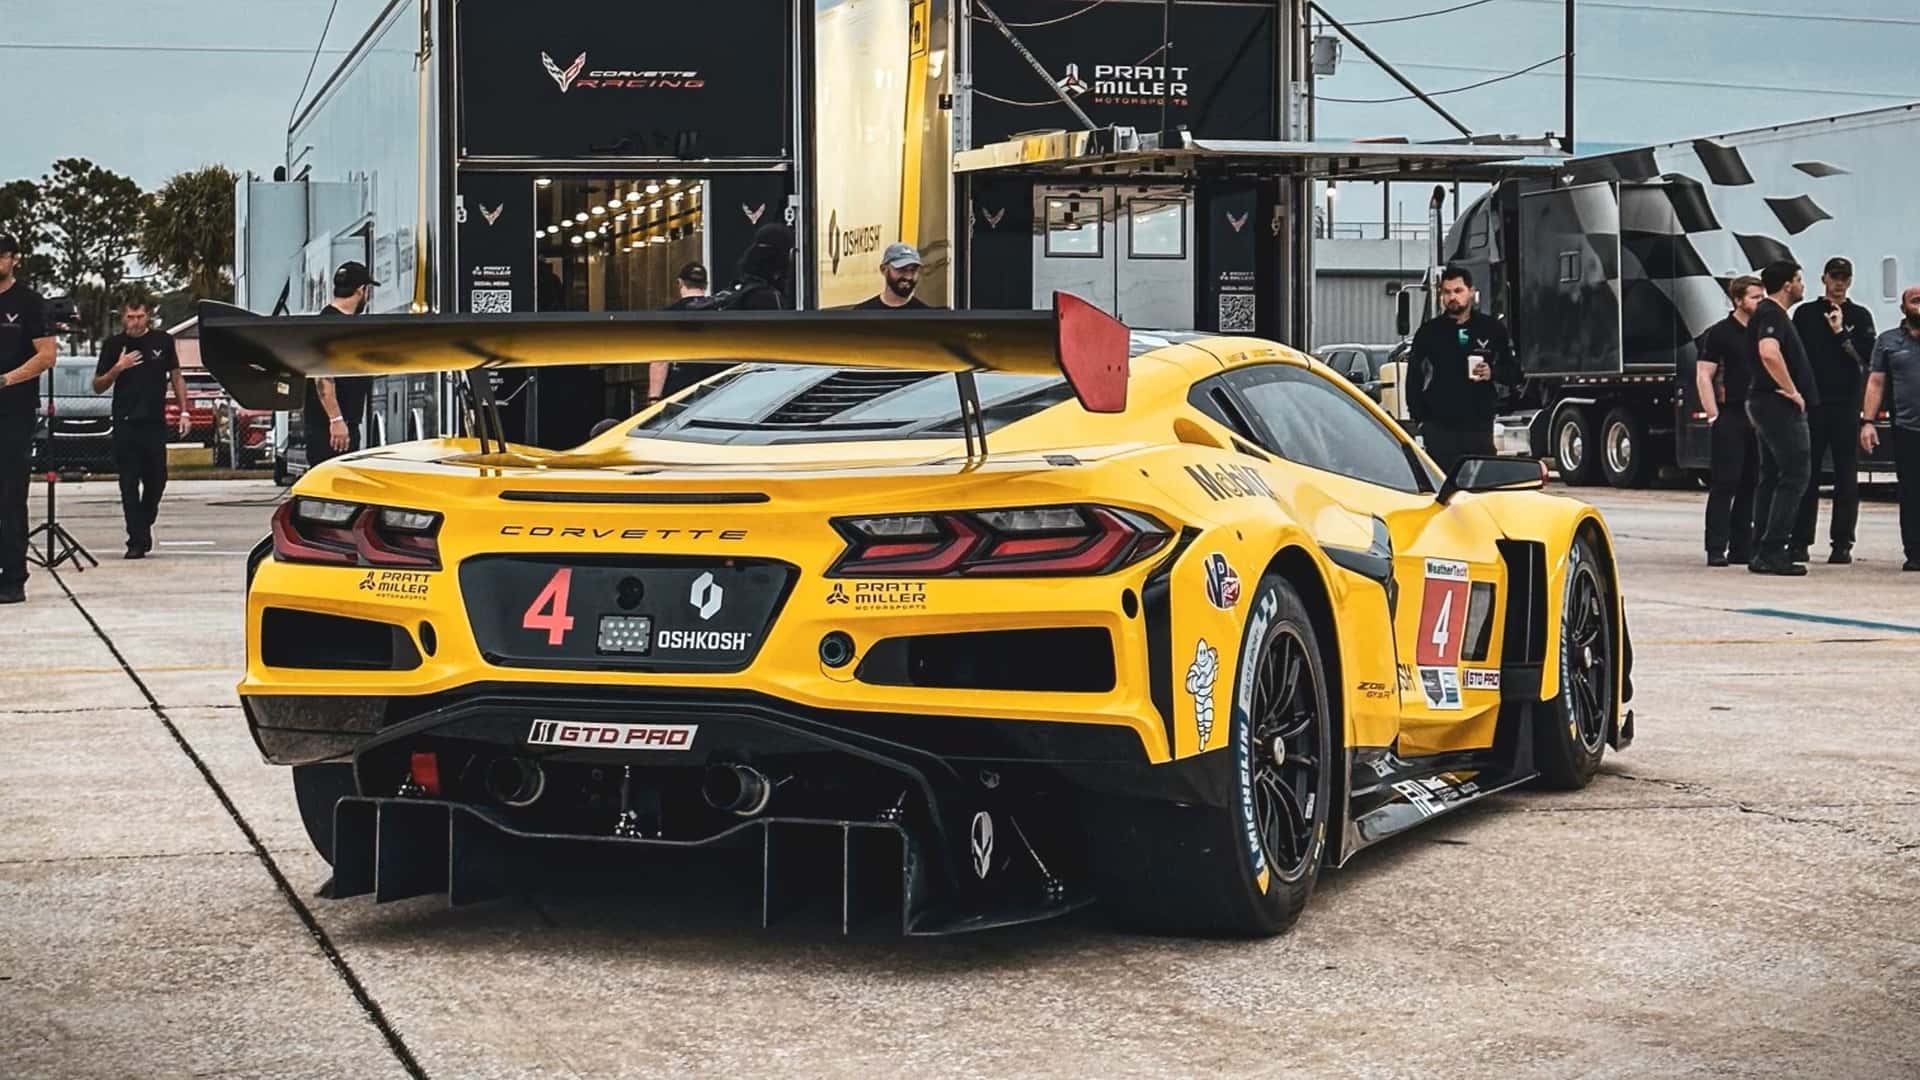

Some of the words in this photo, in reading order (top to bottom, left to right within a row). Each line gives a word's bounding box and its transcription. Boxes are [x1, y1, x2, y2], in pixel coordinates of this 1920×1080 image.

[589, 70, 698, 78] CORVETTE
[1095, 65, 1189, 80] PRATT
[576, 79, 705, 88] RACING
[1095, 81, 1188, 96] MILLER
[1095, 97, 1188, 106] MOTORSPOTS
[842, 225, 881, 257] OSHKOSH
[500, 525, 748, 540] CORVETTE
[381, 571, 431, 583] PRATT
[378, 582, 429, 594] MILLER
[855, 582, 927, 592] PRATT
[855, 593, 927, 603] MILLER
[523, 567, 574, 645] 4
[1432, 590, 1453, 657] 4
[559, 726, 620, 743] GTD
[624, 729, 690, 745] PRO
[1240, 721, 1259, 853] MICHELIN
